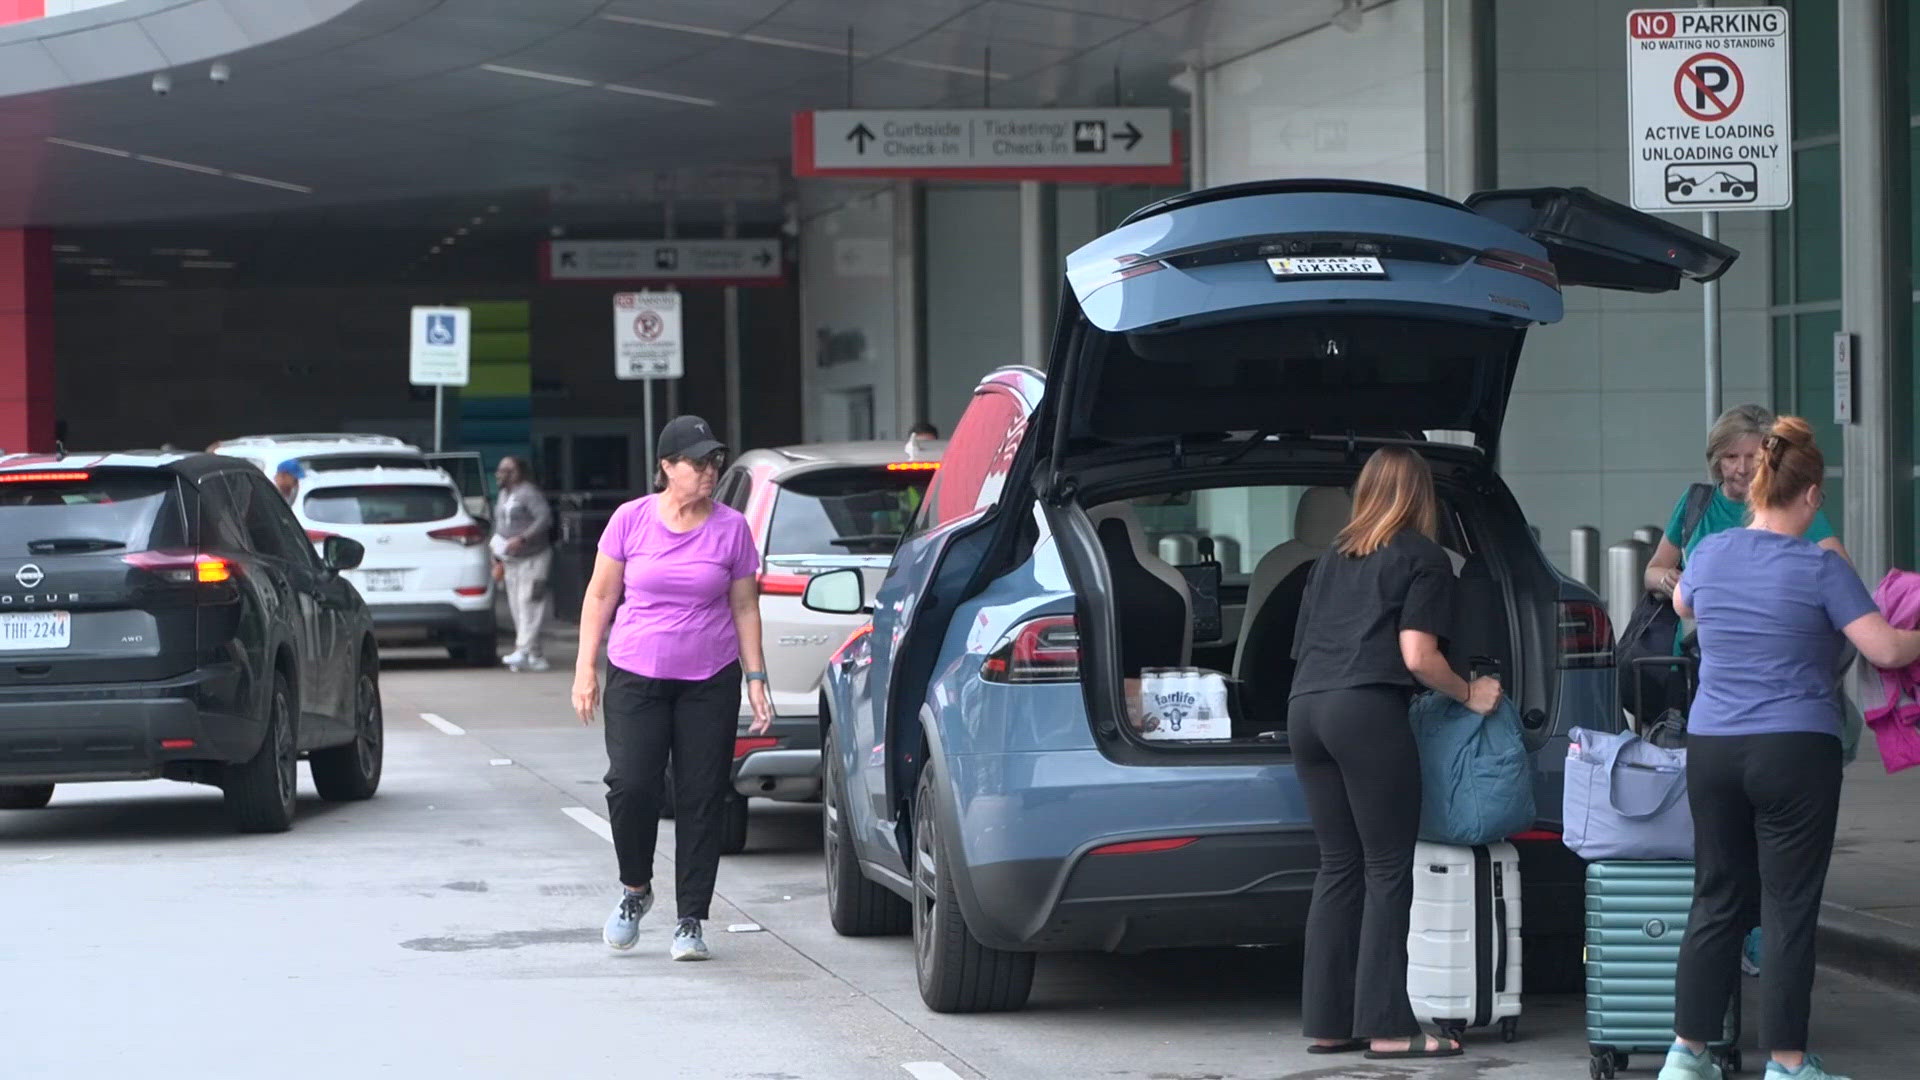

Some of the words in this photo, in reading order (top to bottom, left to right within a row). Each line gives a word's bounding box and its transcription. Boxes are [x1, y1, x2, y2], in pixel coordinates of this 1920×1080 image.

[1637, 15, 1668, 35] NO
[1682, 13, 1777, 33] PARKING
[1641, 41, 1656, 50] NO
[1659, 39, 1702, 50] WAITING
[1705, 39, 1720, 48] NO
[1723, 38, 1775, 48] STANDING
[883, 121, 961, 137] Curbside
[983, 120, 1067, 138] Ticketing/
[1645, 126, 1700, 140] ACTIVE
[1706, 124, 1775, 139] LOADING
[883, 140, 960, 156] Check-In
[992, 139, 1069, 156] Check-In
[1642, 146, 1733, 161] UNLOADING
[1738, 145, 1778, 159] ONLY
[1, 592, 79, 604] OGUE
[4, 621, 65, 639] THH-2244
[1155, 691, 1195, 705] fairlife
